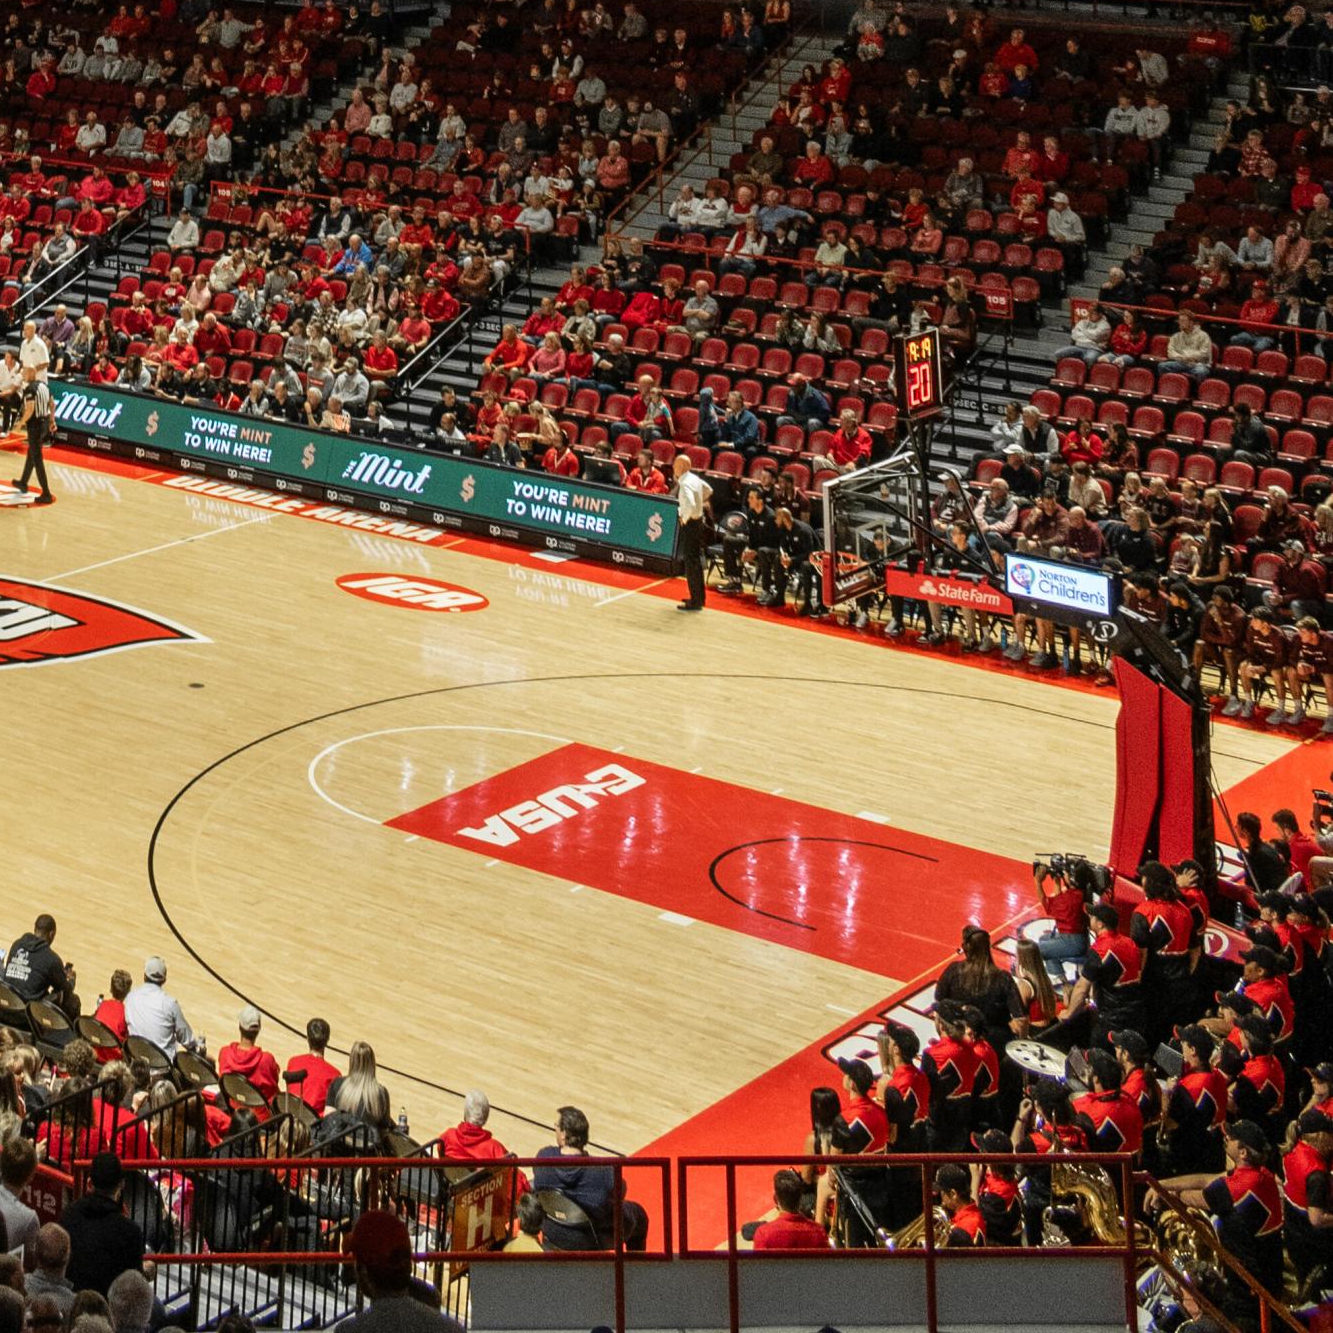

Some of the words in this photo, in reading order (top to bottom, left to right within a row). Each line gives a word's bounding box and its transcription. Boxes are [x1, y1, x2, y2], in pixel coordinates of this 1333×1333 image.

[909, 337, 932, 361] 9:19
[909, 363, 931, 406] 20
[55, 391, 123, 429] Mint
[191, 416, 238, 439] YOU'RE
[241, 426, 272, 445] MINT
[184, 432, 201, 449] TO
[205, 436, 230, 454] WIN
[233, 443, 272, 464] HERE!
[352, 451, 433, 494] Mint
[513, 480, 568, 505] YOU'RE
[571, 493, 610, 514] MINT
[506, 498, 526, 515] TO
[530, 505, 561, 524] WIN
[566, 512, 611, 534] HERE!
[341, 576, 484, 610] IGA
[1038, 579, 1106, 607] Children's
[1039, 569, 1078, 586] NORTON
[460, 1175, 504, 1209] SECTION
[467, 1194, 494, 1252] H
